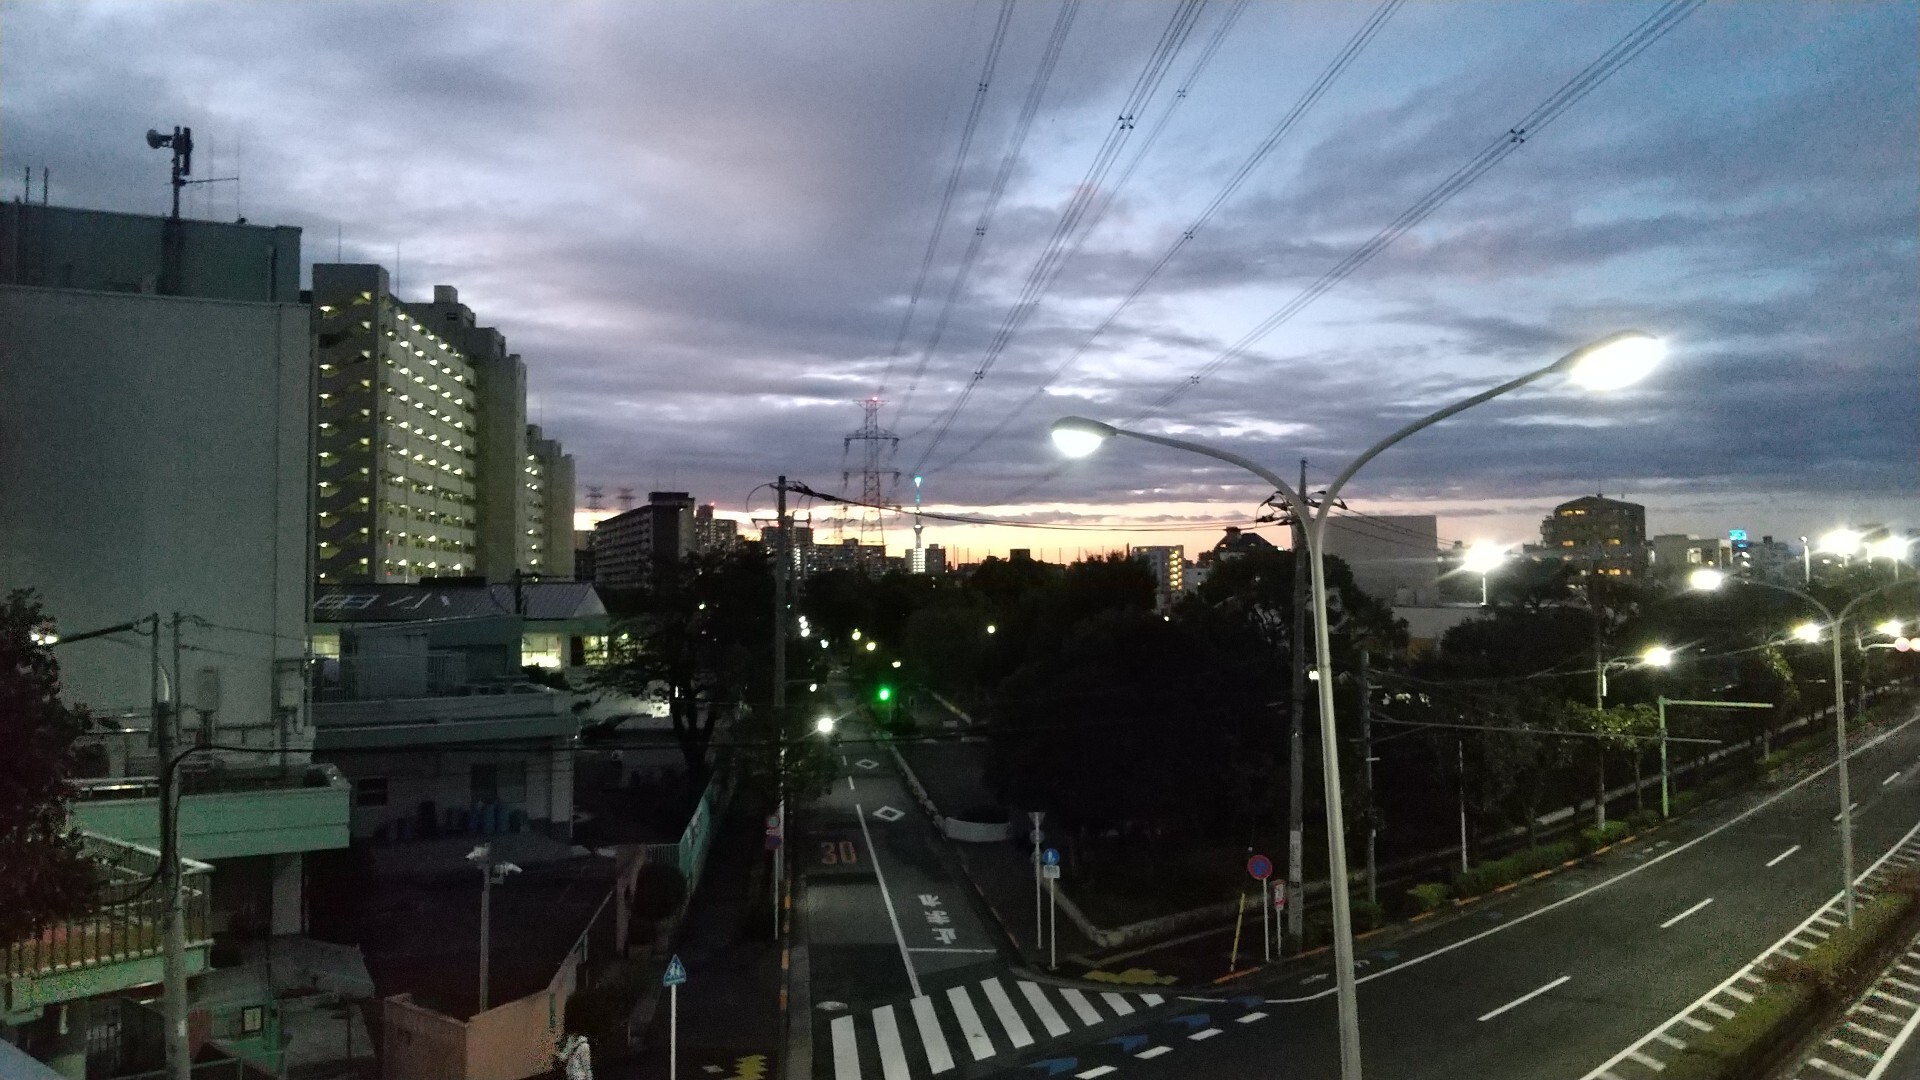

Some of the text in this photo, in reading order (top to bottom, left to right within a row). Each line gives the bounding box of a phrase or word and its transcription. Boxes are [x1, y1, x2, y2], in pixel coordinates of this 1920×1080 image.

[820, 841, 857, 865] 30
[917, 894, 957, 945] 止まれ
